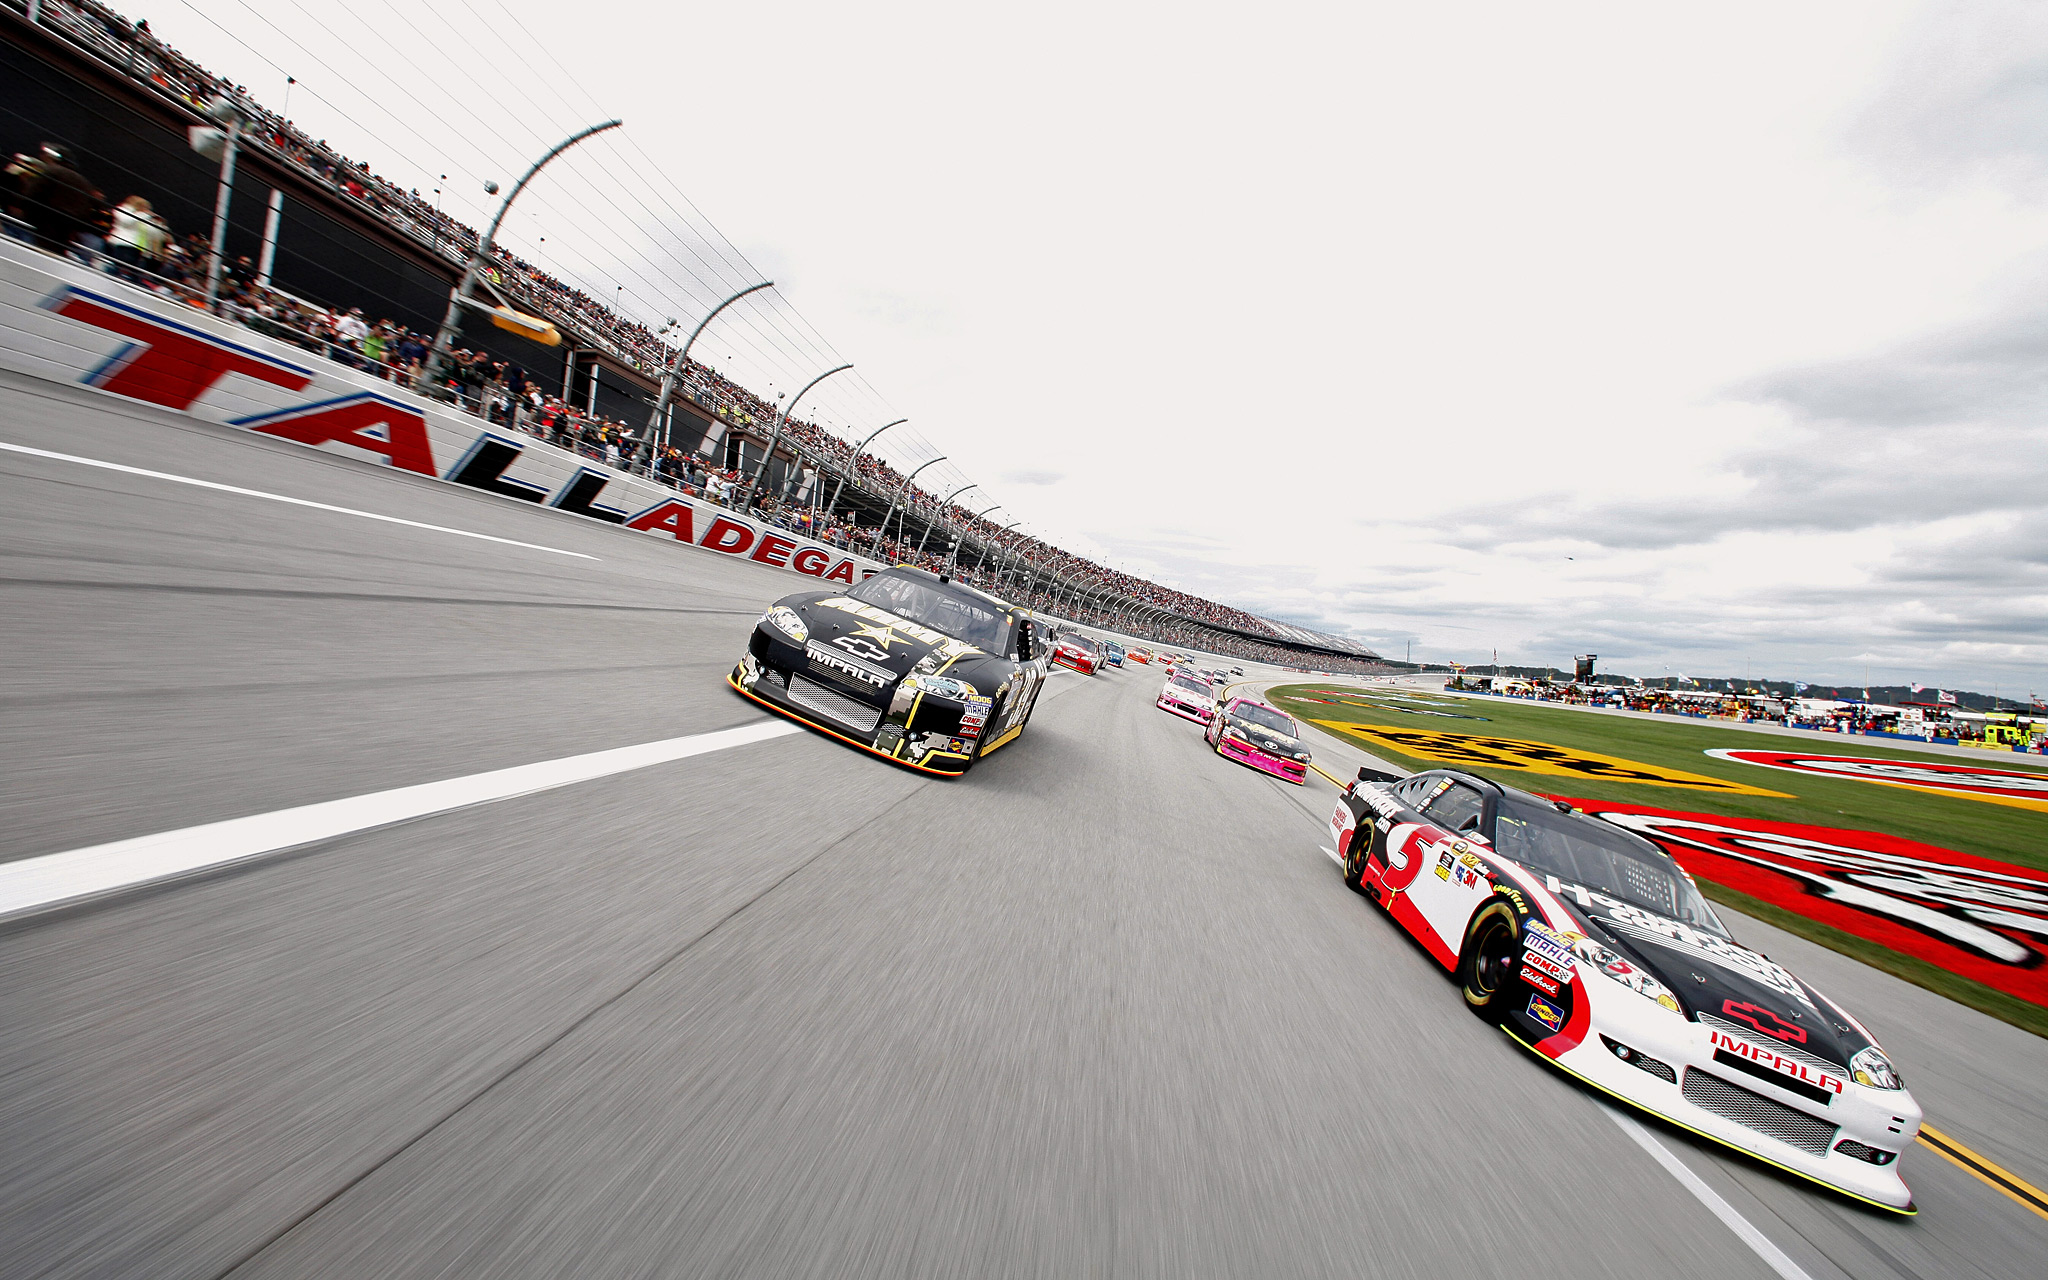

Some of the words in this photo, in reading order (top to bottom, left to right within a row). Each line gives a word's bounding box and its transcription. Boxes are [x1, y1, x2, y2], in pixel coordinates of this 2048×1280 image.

[36, 285, 855, 585] TALLADEGA
[806, 648, 886, 689] IMPALA
[965, 704, 989, 716] MAHLE
[968, 694, 993, 705] MOOG
[1250, 749, 1286, 764] CAMRY
[1381, 824, 1451, 892] 5
[1463, 869, 1478, 890] 3M
[1526, 919, 1576, 947] MOOG
[1525, 934, 1577, 967] MAHLE
[1525, 952, 1560, 974] COMP
[1520, 968, 1558, 994] Edelbrock
[1531, 1003, 1560, 1022] SUNOCO
[1710, 1031, 1844, 1095] IMPALA
